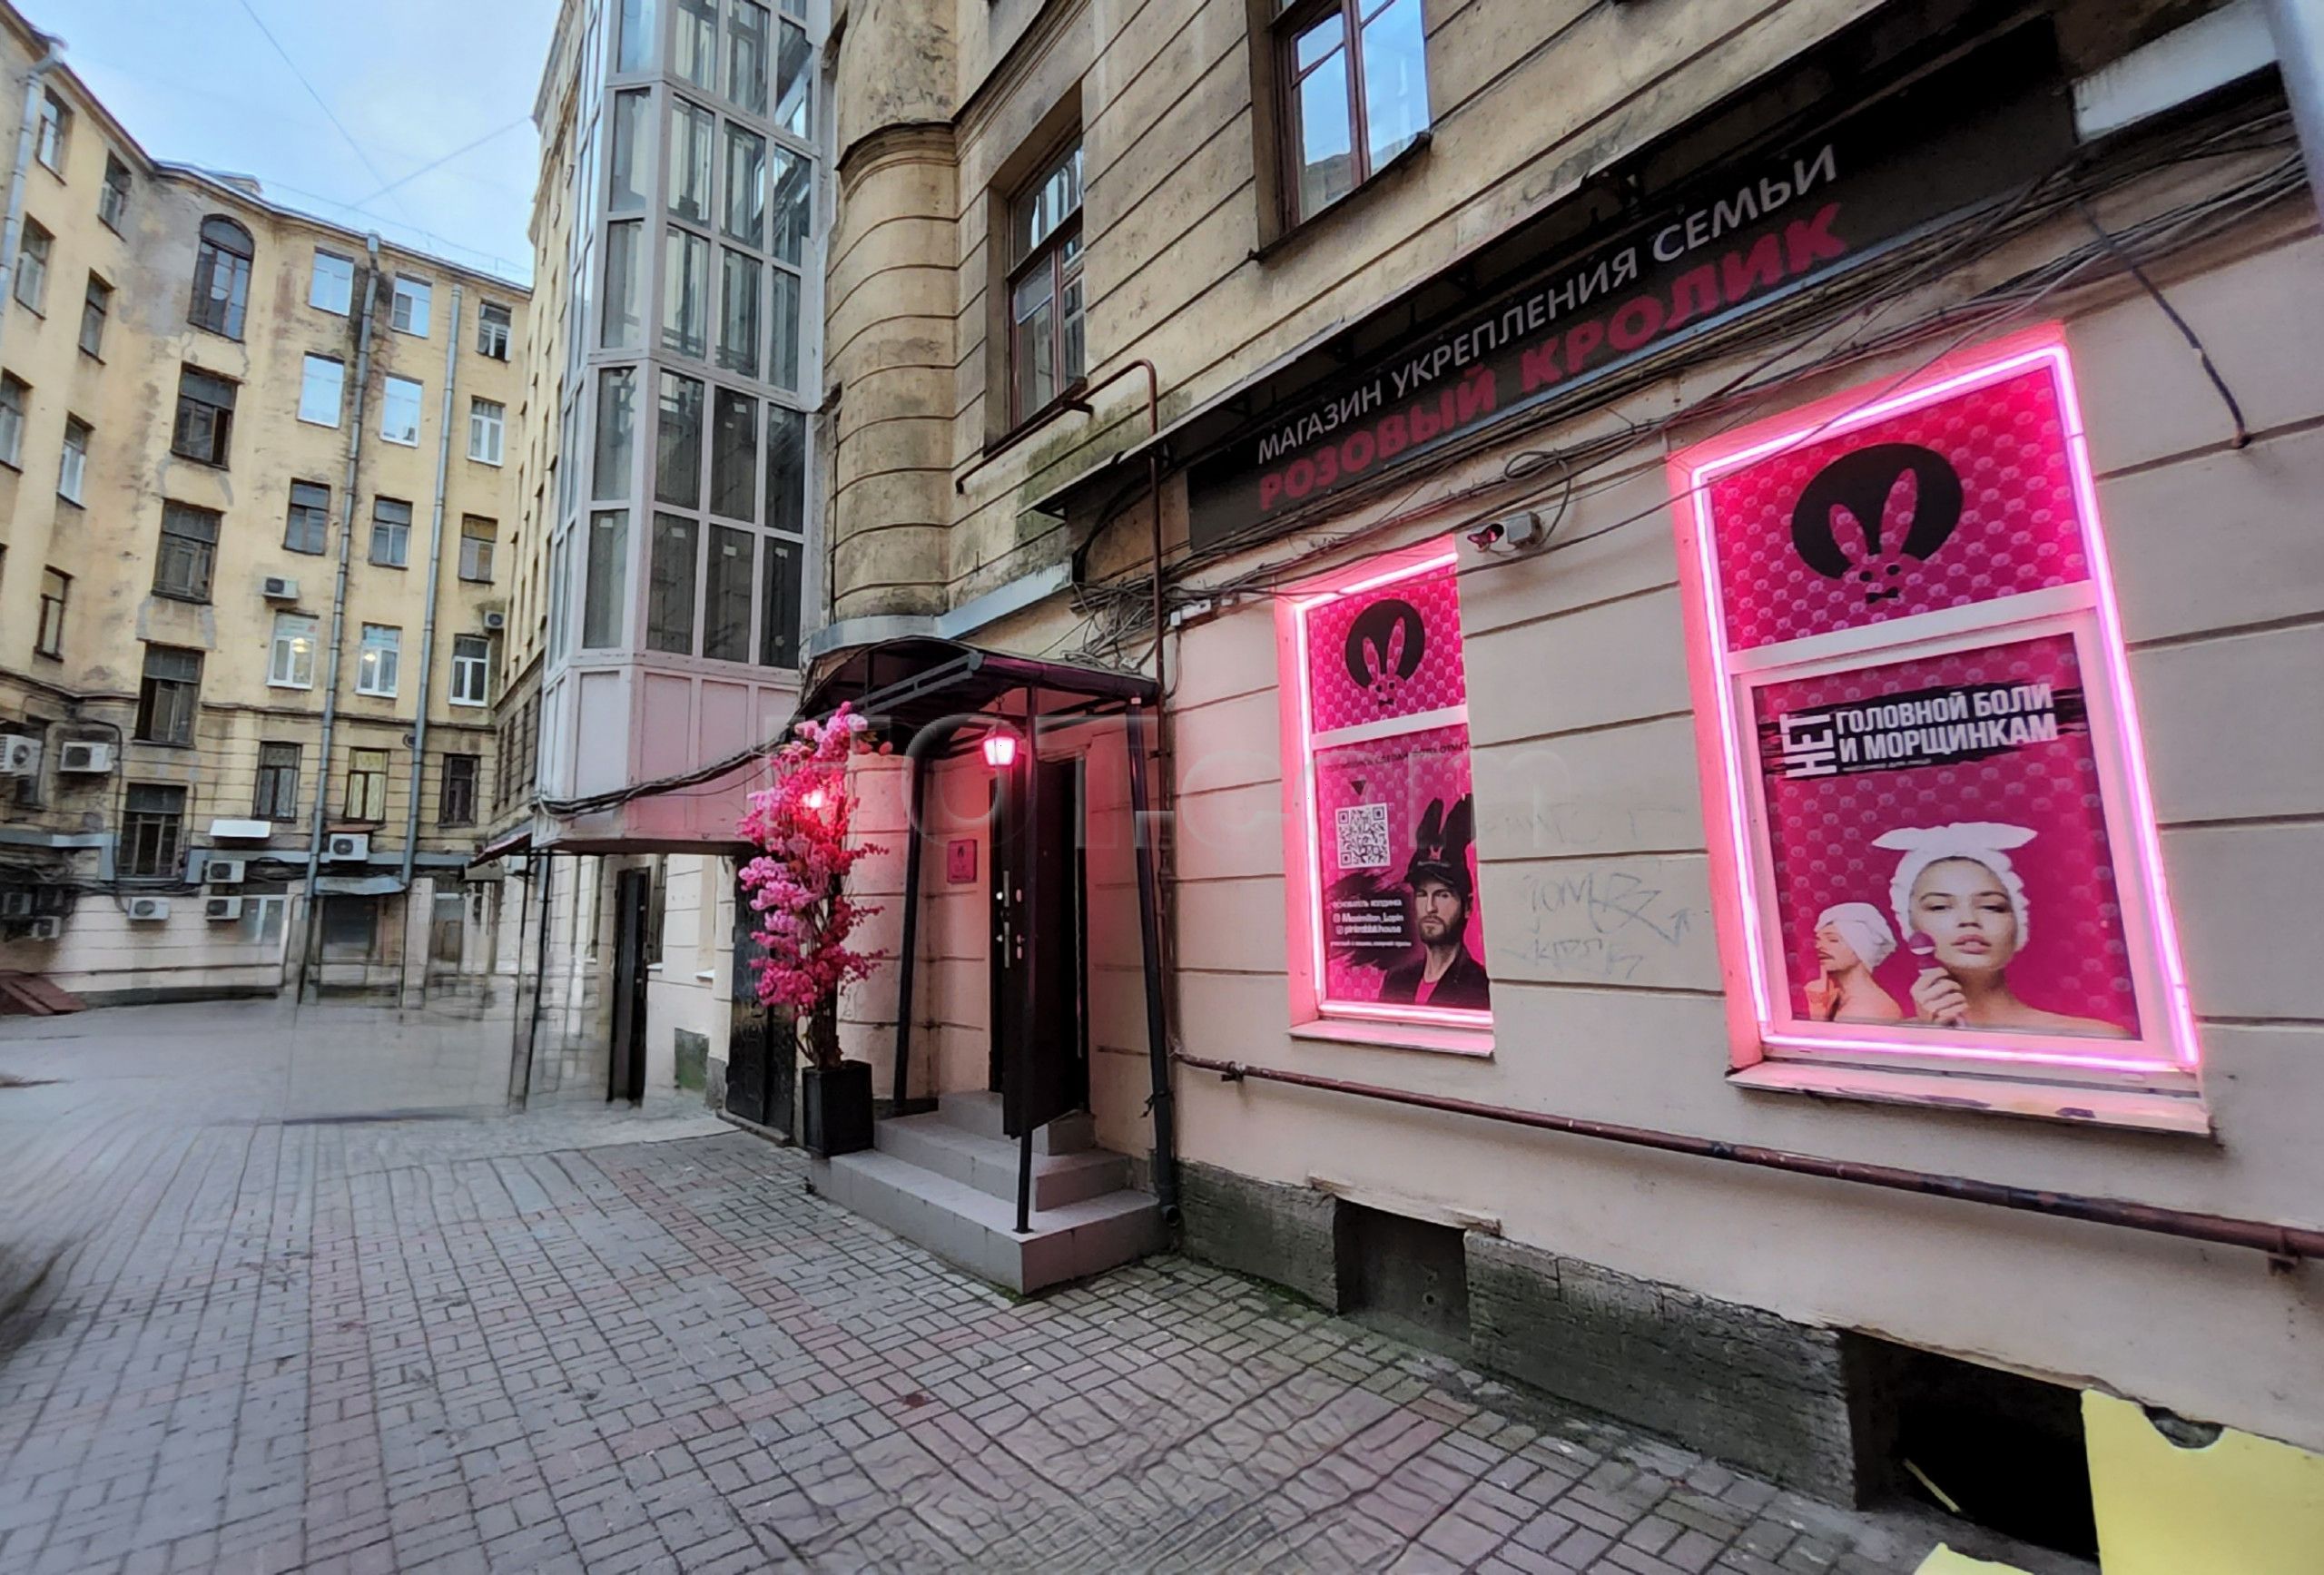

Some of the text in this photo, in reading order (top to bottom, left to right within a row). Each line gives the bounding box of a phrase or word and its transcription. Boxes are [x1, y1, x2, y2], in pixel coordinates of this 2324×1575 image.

[1258, 143, 1838, 465] МАГАЗИН УКРЕПЛЕНИЯ СЕМЬИ
[1259, 202, 1848, 511] РОЗОВЫЙ КРОЛИК
[1835, 683, 2054, 735] ГОЛОВНОЙ БОЛИ
[1838, 713, 2059, 763] И МОРЩИНКАМ
[1778, 713, 1837, 779] НЕТ
